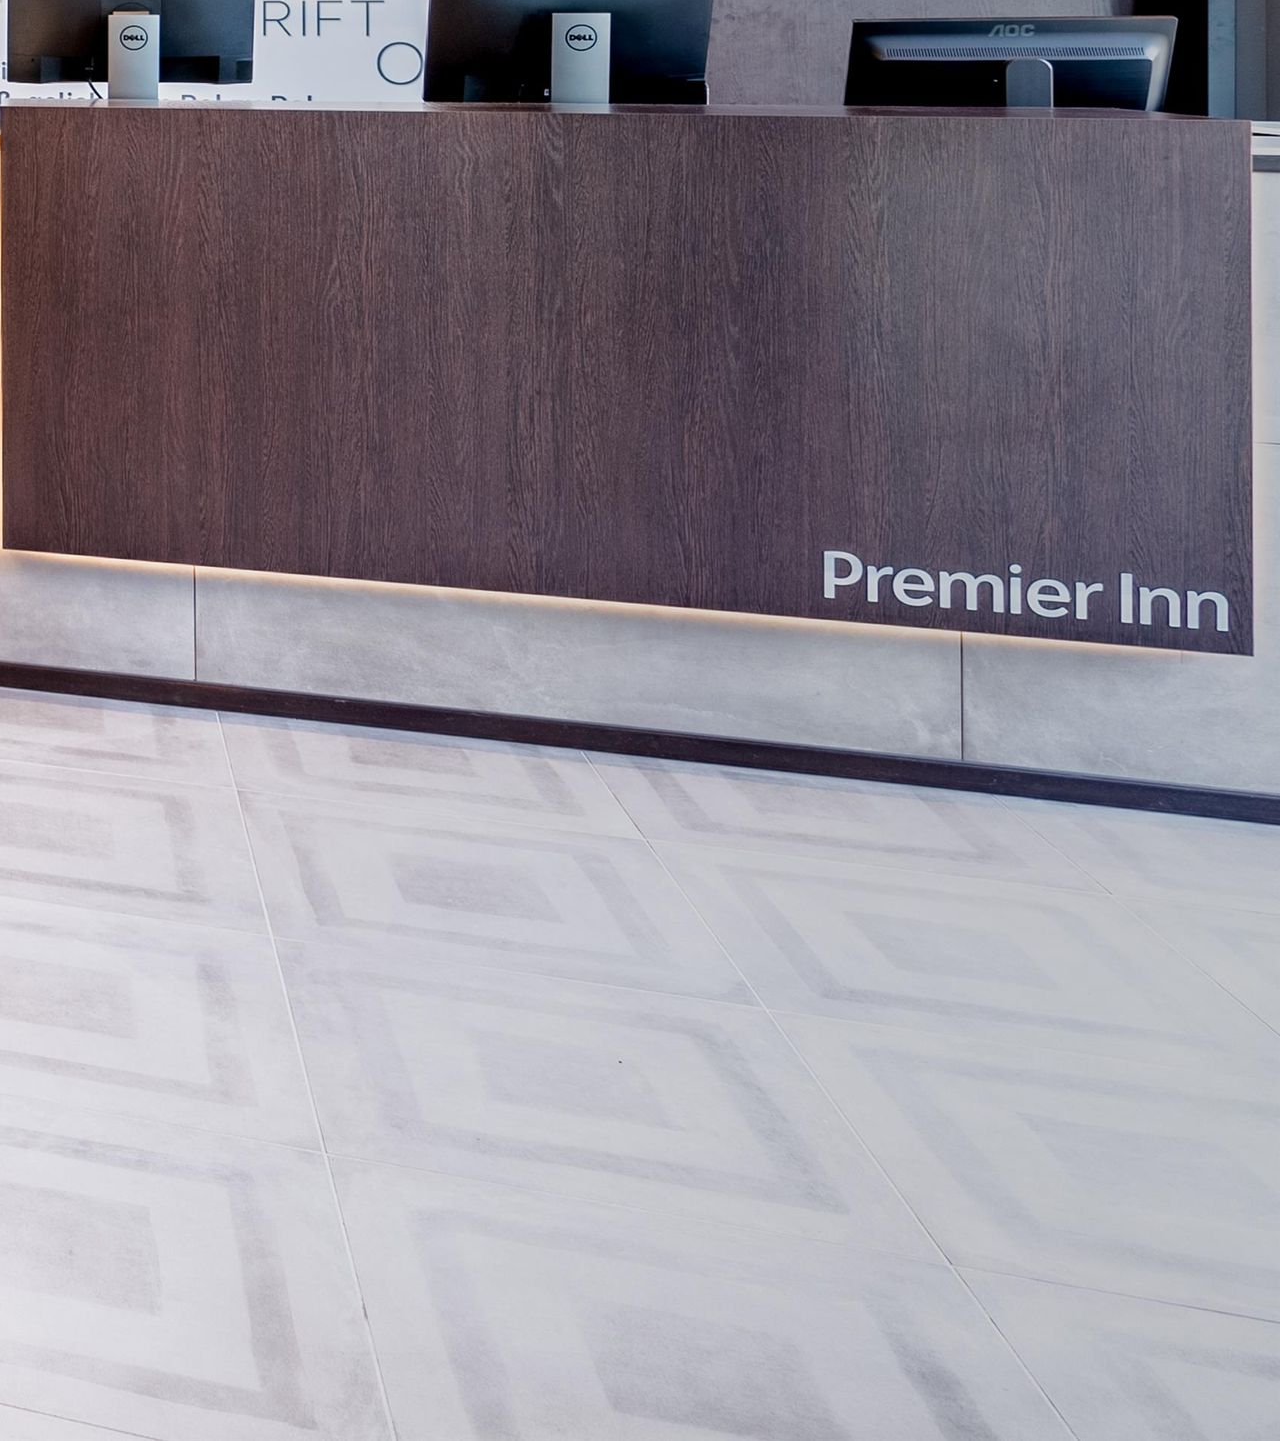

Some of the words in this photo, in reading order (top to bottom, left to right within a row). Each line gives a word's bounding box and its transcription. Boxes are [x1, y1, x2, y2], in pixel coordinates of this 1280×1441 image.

[262, 0, 385, 37] RIFT
[988, 24, 1036, 37] AOC
[823, 549, 1104, 620] Premier
[1120, 572, 1229, 632] Inn
